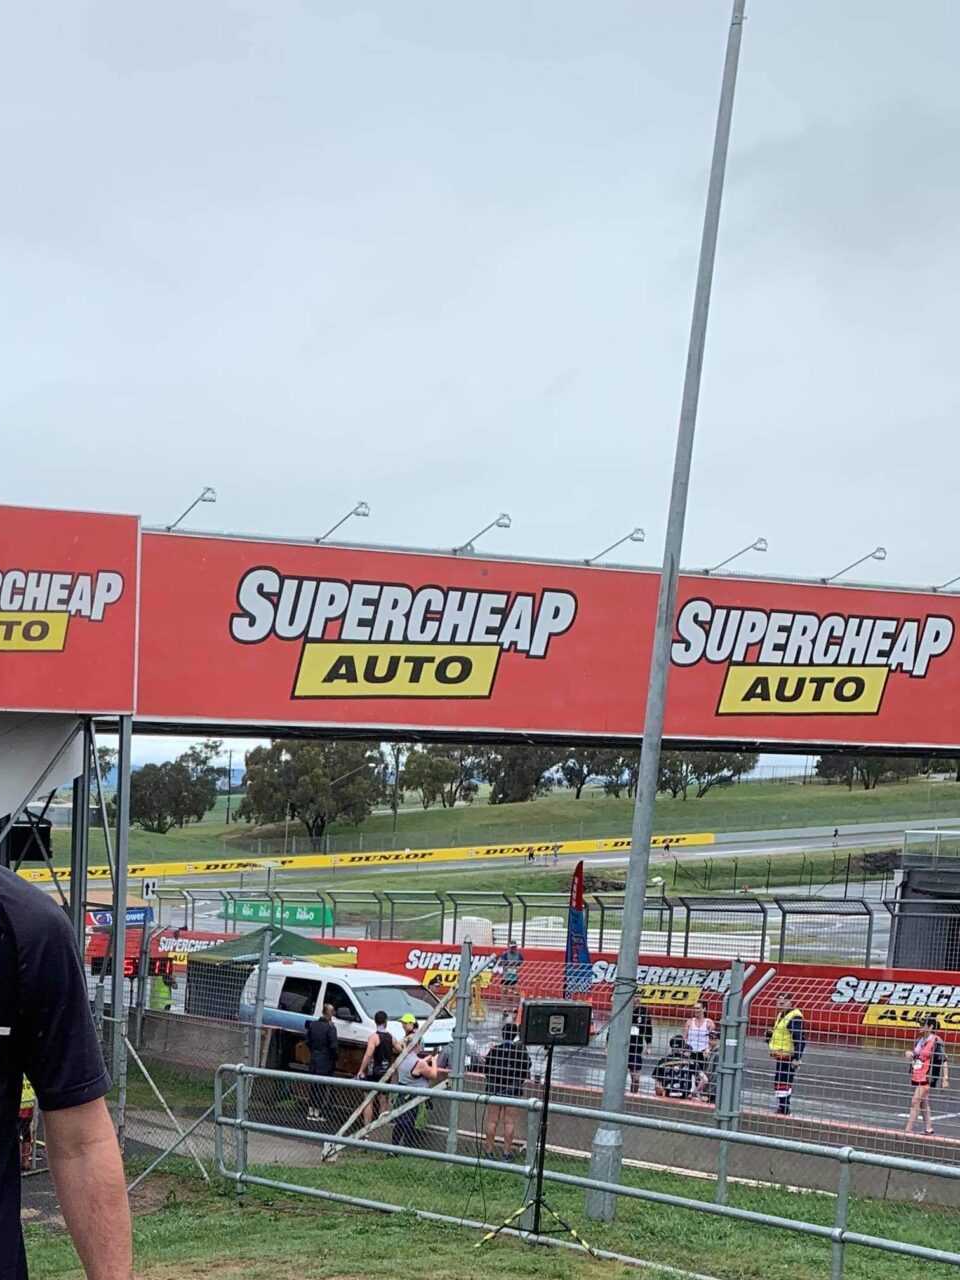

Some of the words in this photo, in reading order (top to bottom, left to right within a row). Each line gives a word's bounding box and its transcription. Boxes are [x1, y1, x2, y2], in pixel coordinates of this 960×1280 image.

[230, 567, 578, 658] SUPERCHEAP
[671, 598, 954, 678] SUPERCHEAP
[321, 655, 474, 685] AUTO
[741, 676, 866, 702] AUTO
[612, 836, 686, 848] DLOP
[348, 852, 434, 863] DUNLOP
